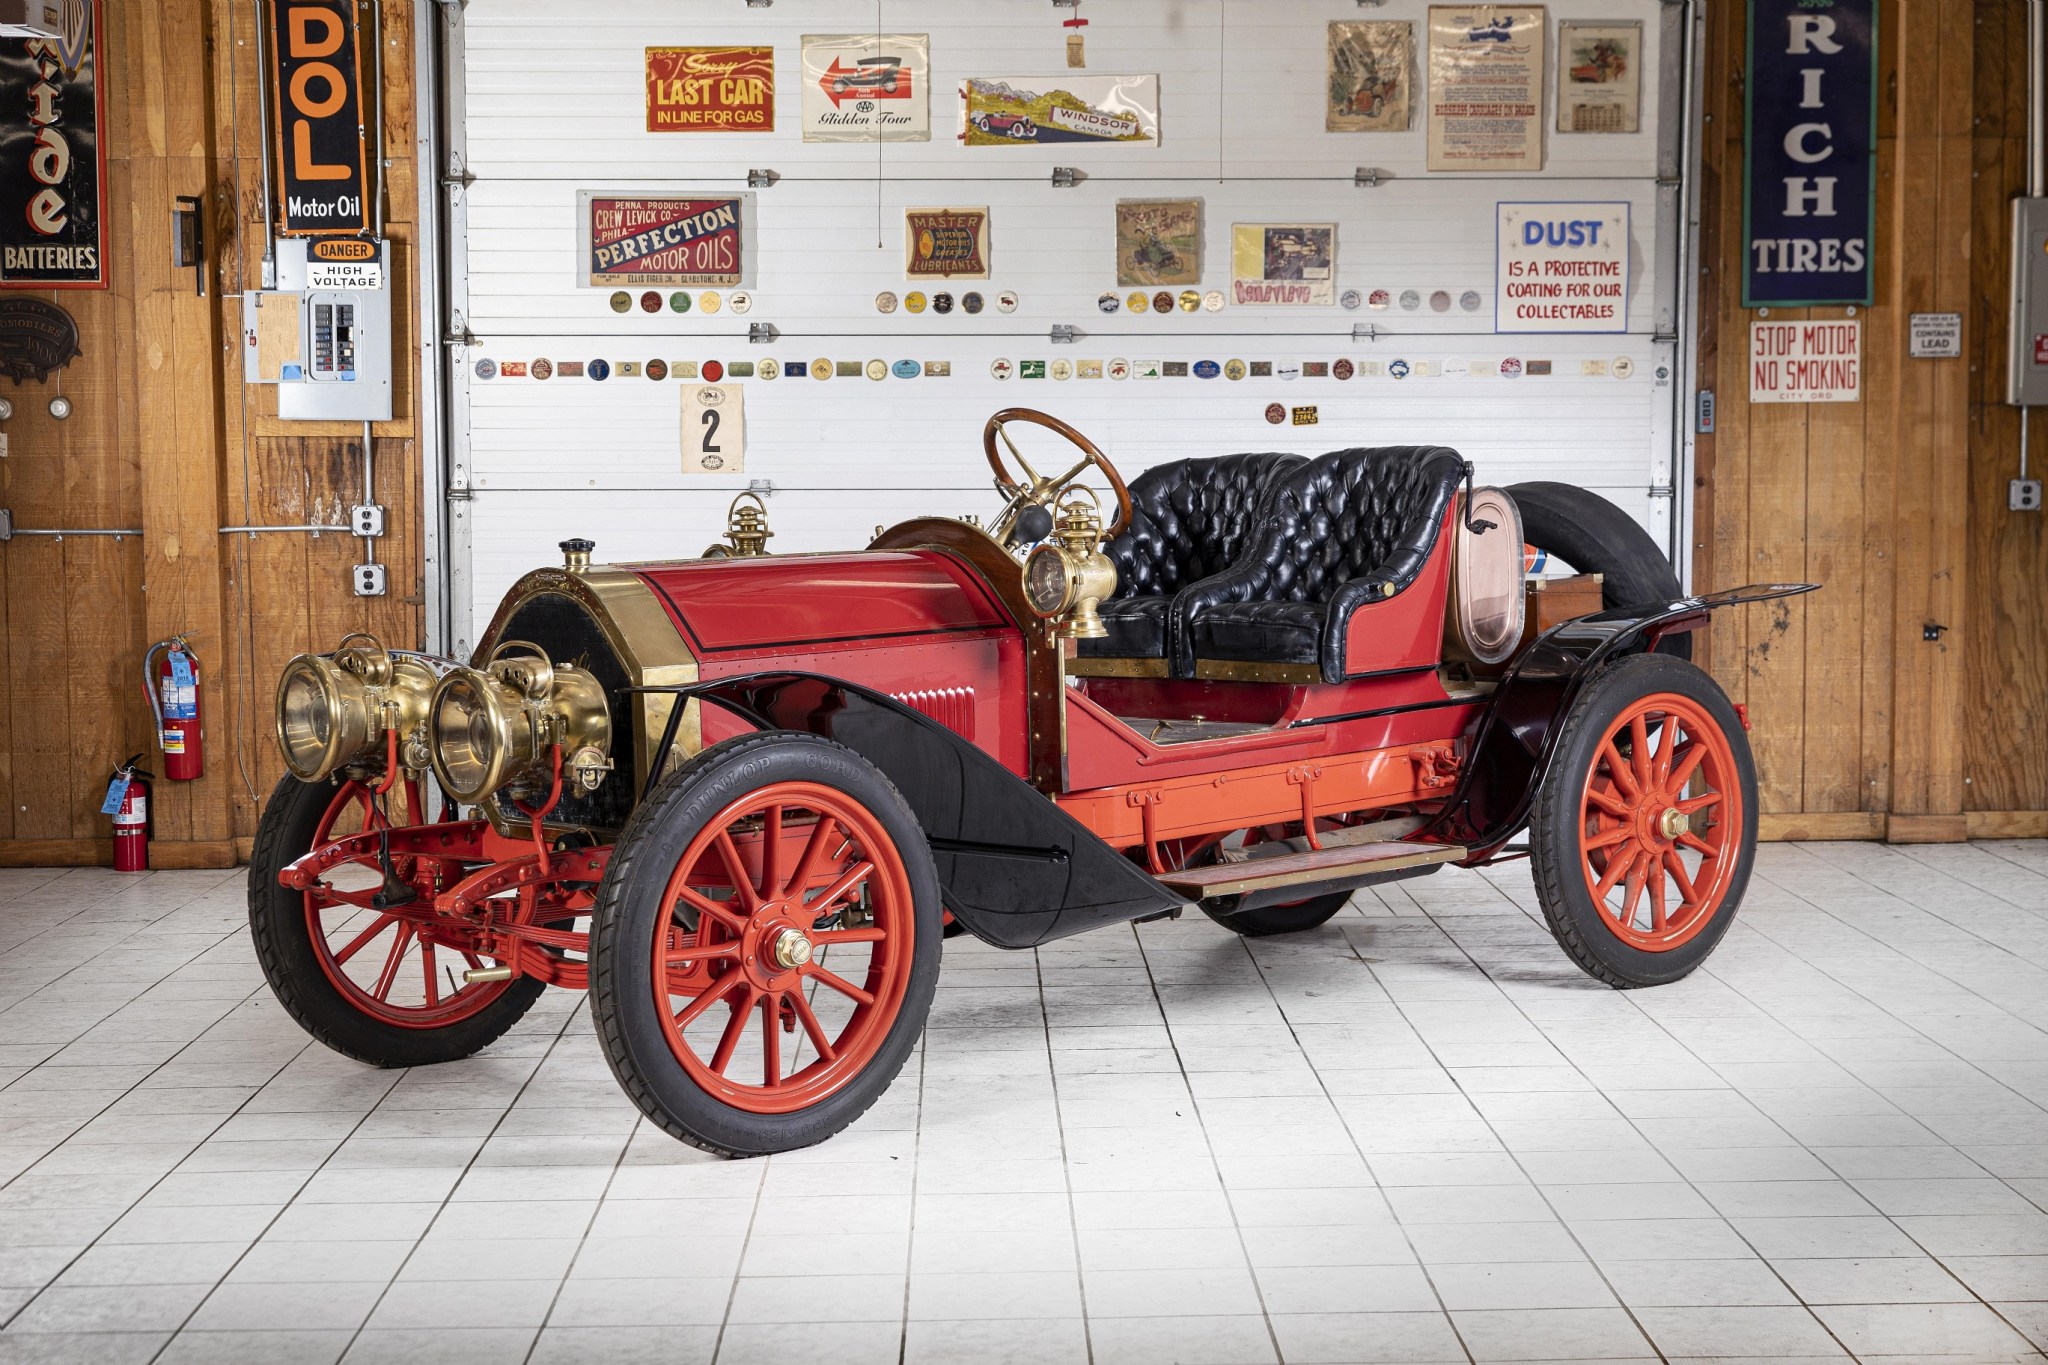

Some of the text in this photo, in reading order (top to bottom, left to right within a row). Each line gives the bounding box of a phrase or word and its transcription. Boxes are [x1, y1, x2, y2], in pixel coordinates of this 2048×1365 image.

[683, 53, 738, 78] Sorry
[288, 0, 352, 180] DOL
[657, 79, 764, 105] LAST CAR
[657, 110, 764, 123] IN LINE FOR GAS
[818, 112, 911, 124] Glidden Tour
[1060, 109, 1131, 131] WINDSOR
[1074, 124, 1112, 136] CANADA
[288, 195, 360, 217] Motor Oil
[615, 201, 690, 211] PENNA. PRODUCTS
[595, 209, 623, 230] CREW
[626, 209, 657, 226] LEVICK
[914, 217, 978, 228] MASTER
[595, 205, 736, 269] PERFECTION
[1524, 220, 1603, 247] DUST
[4, 246, 98, 270] BATTERIES
[320, 243, 368, 257] DANGER
[640, 235, 733, 270] MOTOR OILS
[1751, 238, 1865, 273] TIRES
[327, 266, 362, 275] HIGH
[914, 260, 980, 271] LUBRICANTS
[1509, 261, 1620, 277] IS A PROTECTIVE
[313, 277, 376, 286] VOLTAGE
[627, 274, 645, 283] ELLIS
[1507, 283, 1622, 298] COATING FOR OUR
[1517, 304, 1614, 319] COLLECTABLES
[1756, 325, 1856, 356] STOP MOTOR
[1915, 330, 1956, 338] CONTAINS
[1921, 339, 1950, 349] LEAD
[1755, 360, 1856, 390] NO SMOKING
[702, 409, 721, 453] 2
[684, 753, 861, 821] DUNLOP CORD
